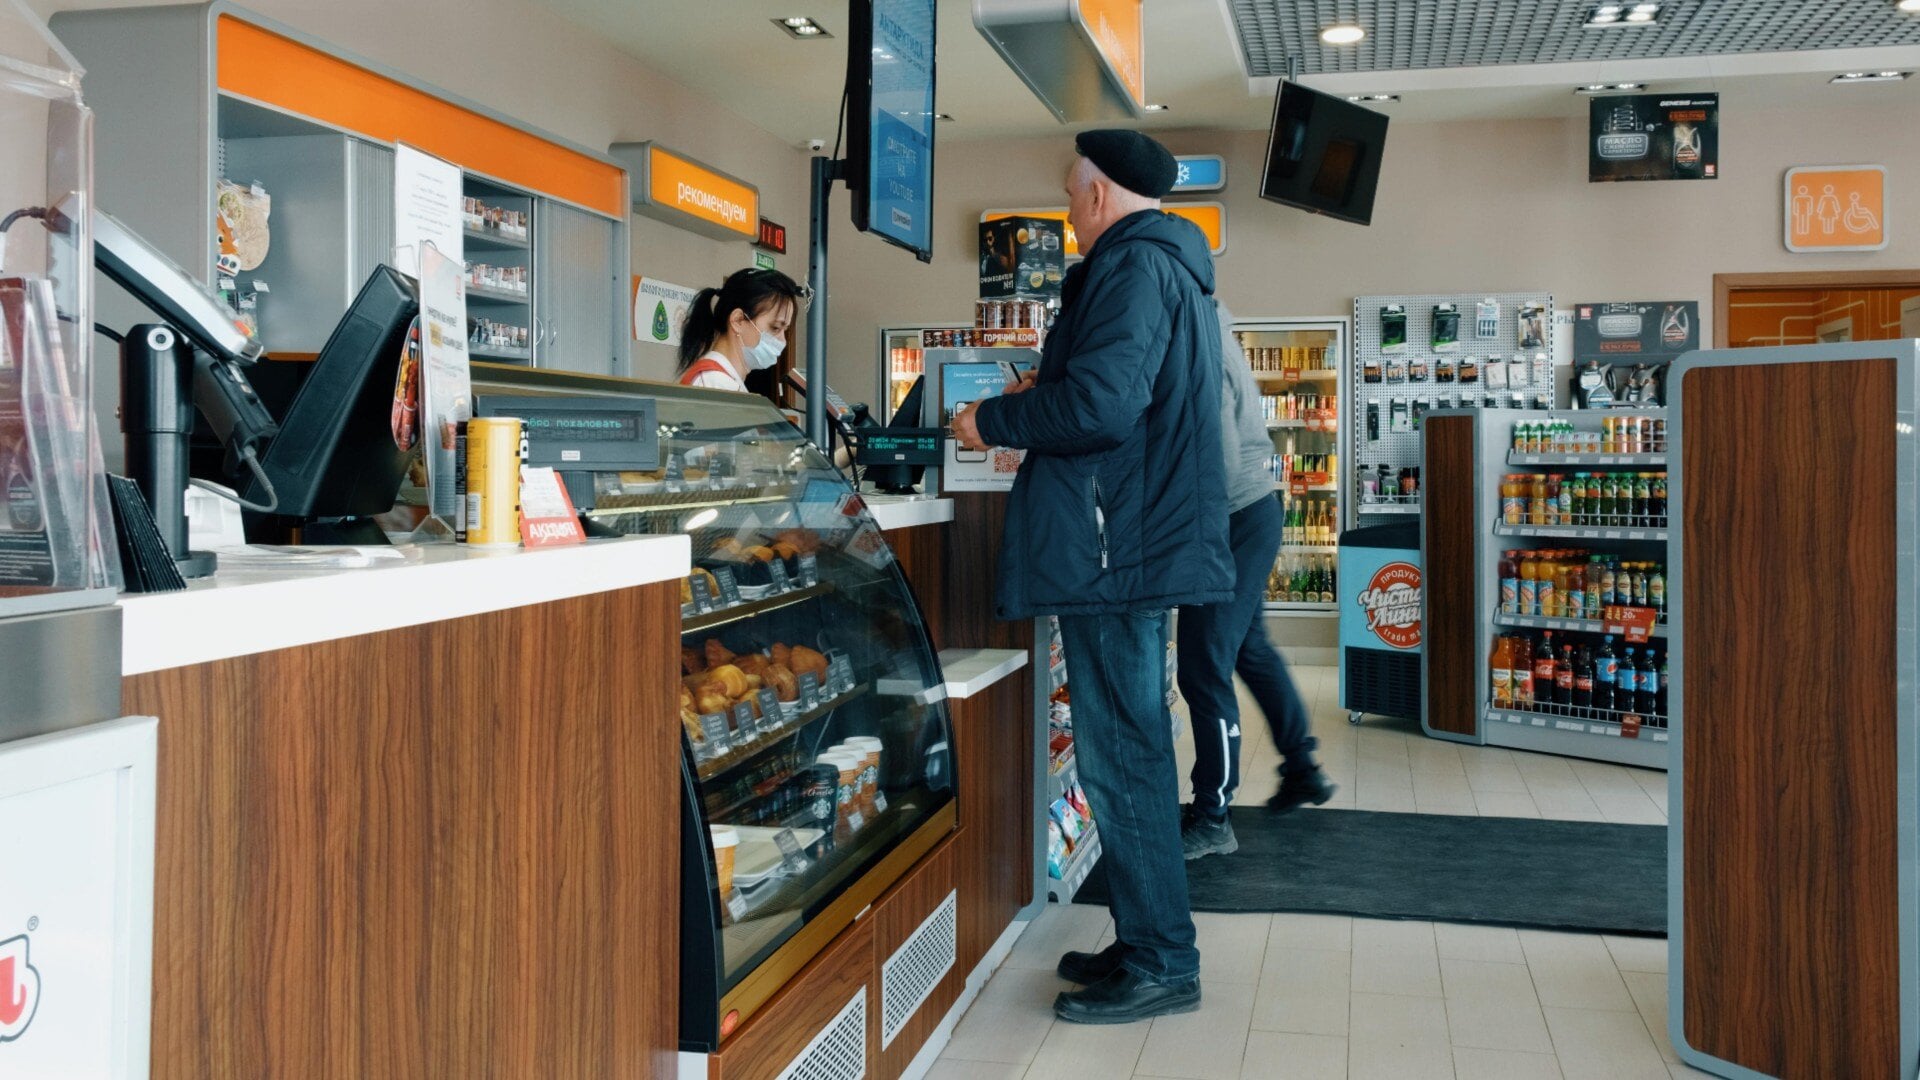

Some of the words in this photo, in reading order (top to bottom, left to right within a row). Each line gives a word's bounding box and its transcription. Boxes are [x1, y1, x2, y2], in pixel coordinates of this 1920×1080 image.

[1604, 137, 1642, 145] МАСЛО
[677, 181, 748, 224] рекомендуем
[983, 332, 1016, 343] ГОРЯЧИЙ
[1017, 333, 1038, 343] КОФЕ
[527, 417, 550, 428] бро
[556, 418, 623, 429] пожаловать
[1383, 628, 1407, 642] trade
